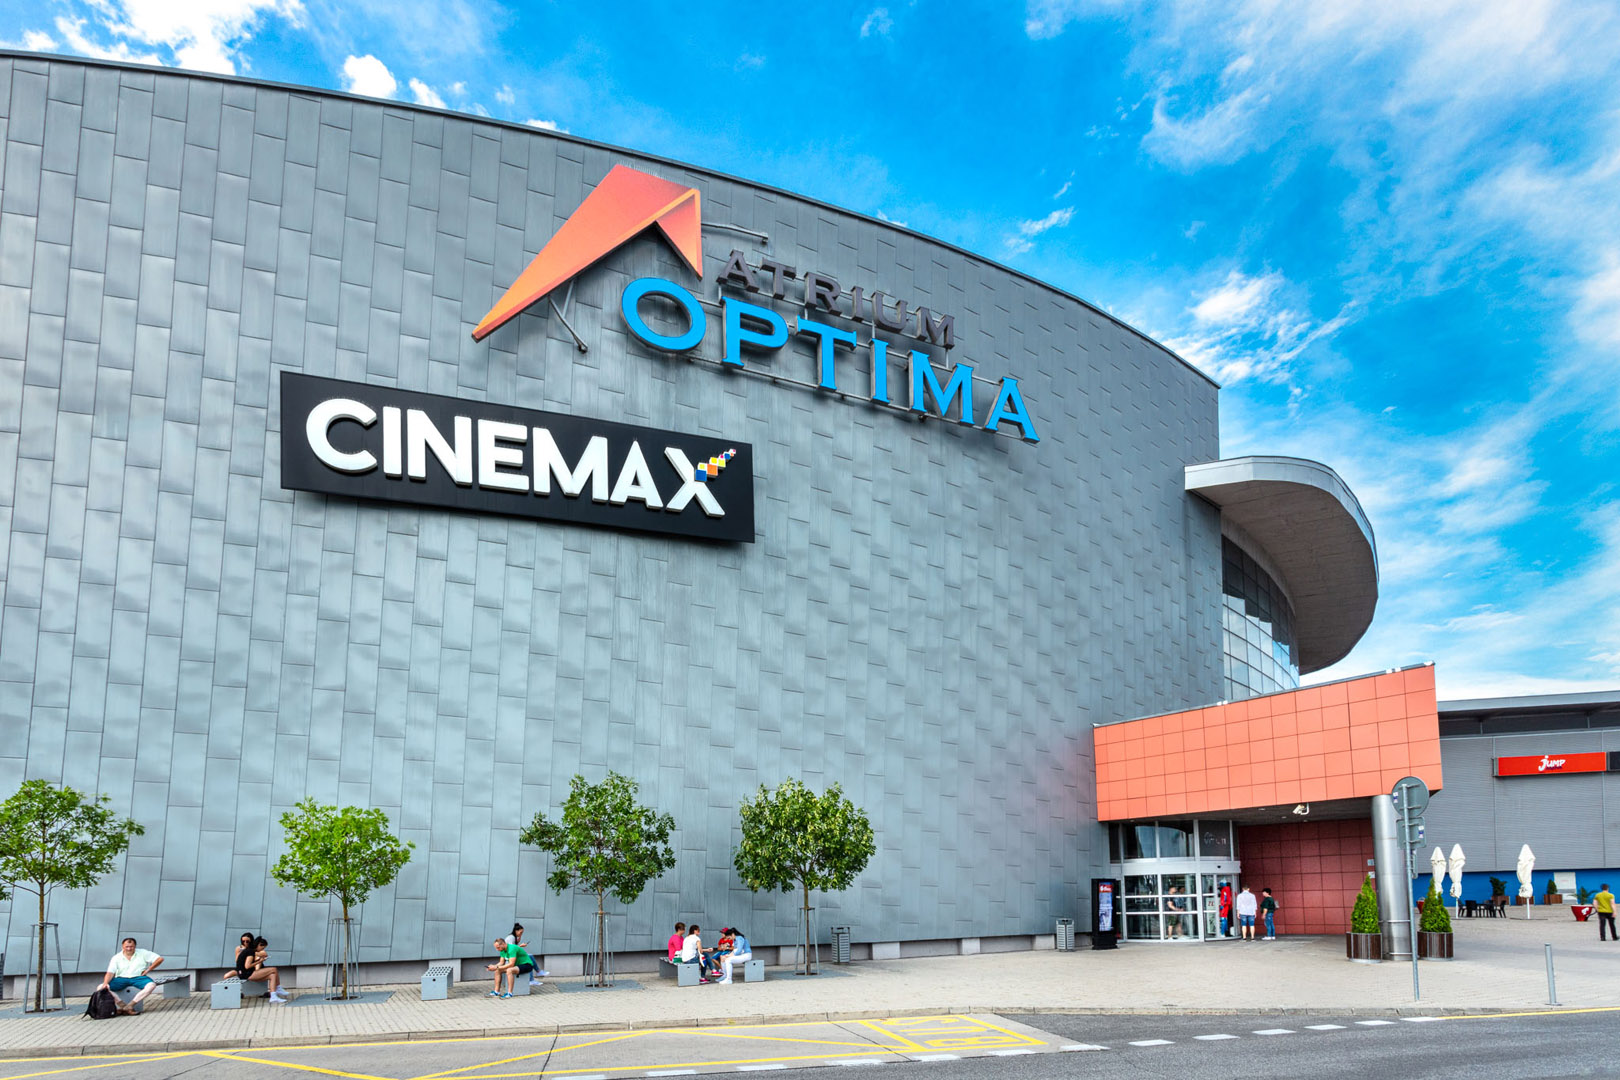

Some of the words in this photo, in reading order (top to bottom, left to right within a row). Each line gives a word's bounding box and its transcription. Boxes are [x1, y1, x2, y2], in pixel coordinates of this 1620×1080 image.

[716, 249, 955, 350] ATRIUM
[621, 277, 1040, 443] OPTIMA
[306, 398, 736, 517] CINEMAX
[880, 1017, 1022, 1047] BUS
